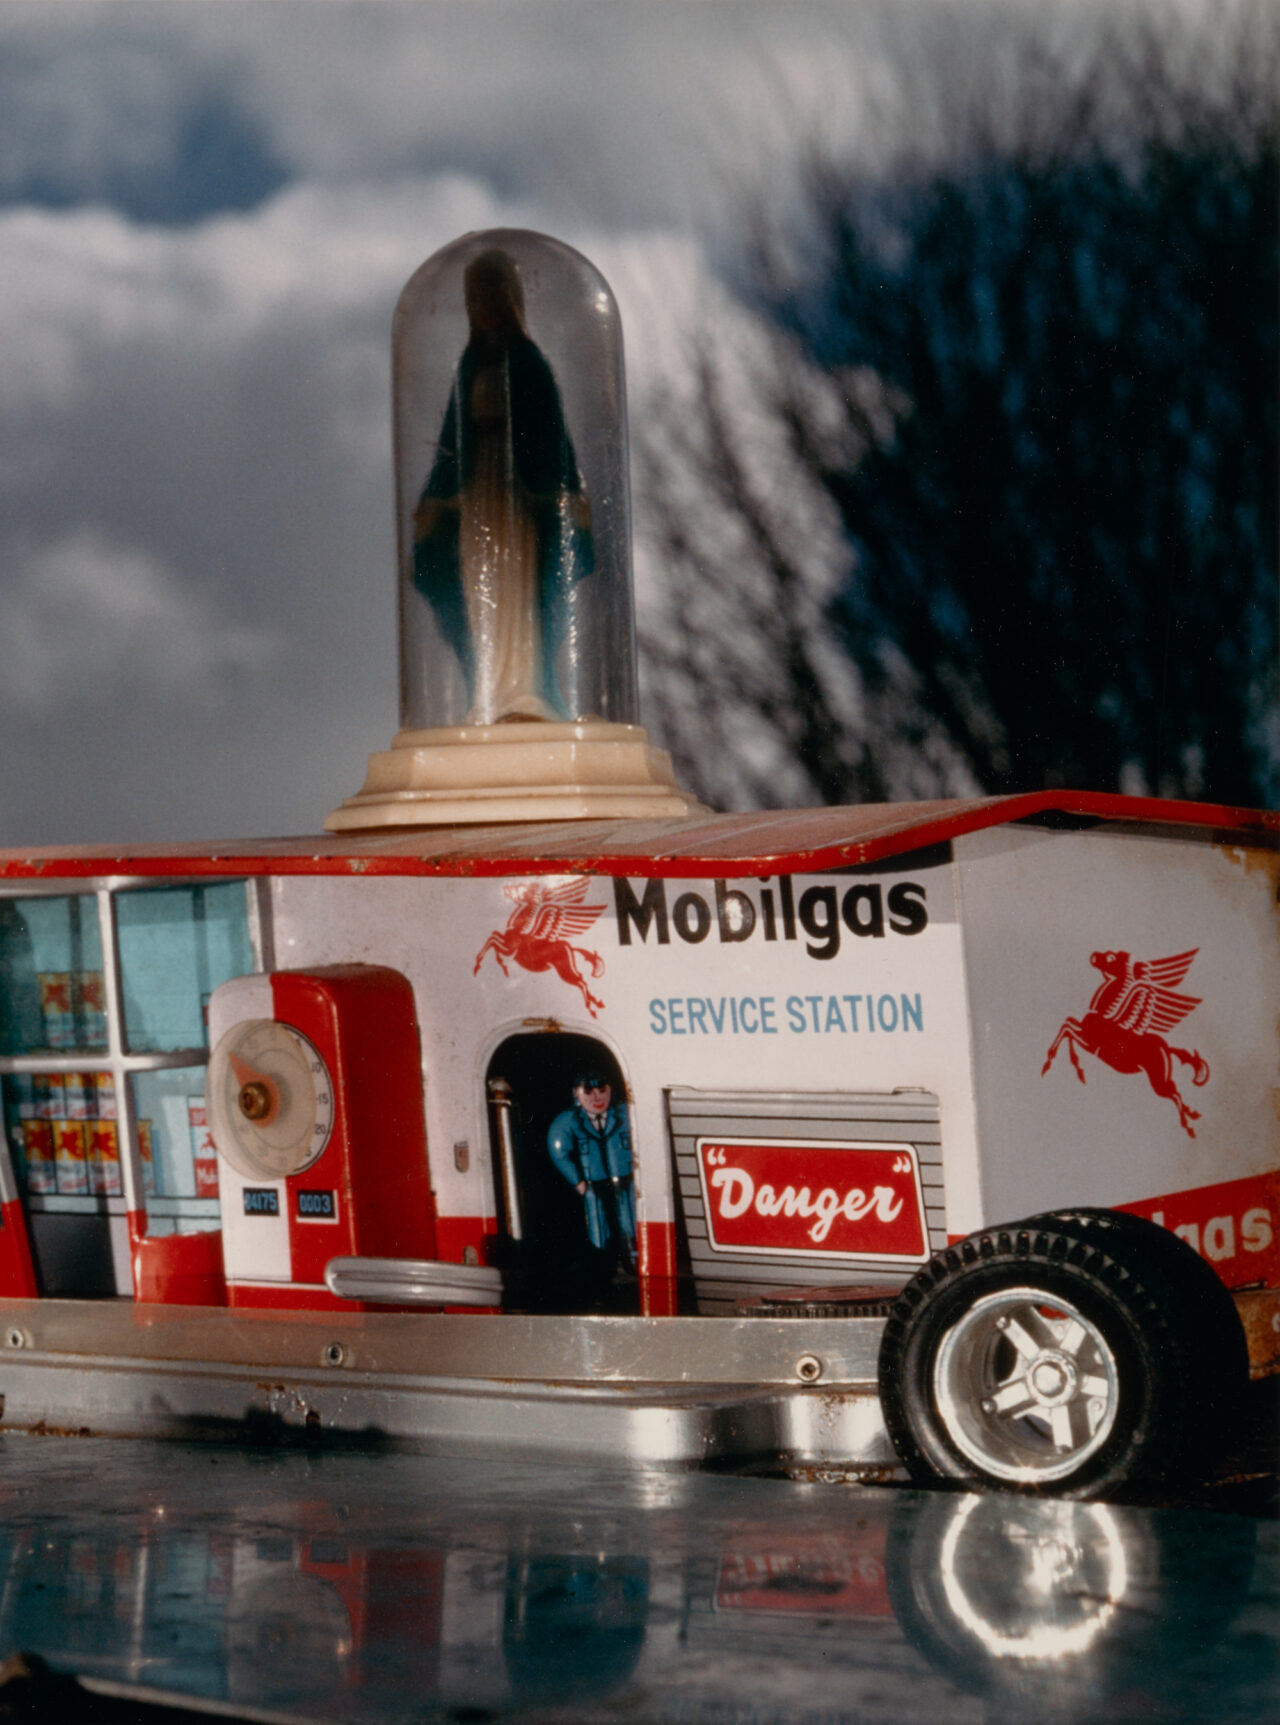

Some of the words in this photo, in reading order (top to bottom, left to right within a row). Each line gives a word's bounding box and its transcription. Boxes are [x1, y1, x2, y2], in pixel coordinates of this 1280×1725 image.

[613, 876, 928, 960] Mobilgas
[649, 997, 778, 1034] SERVICE
[786, 993, 924, 1034] STATION
